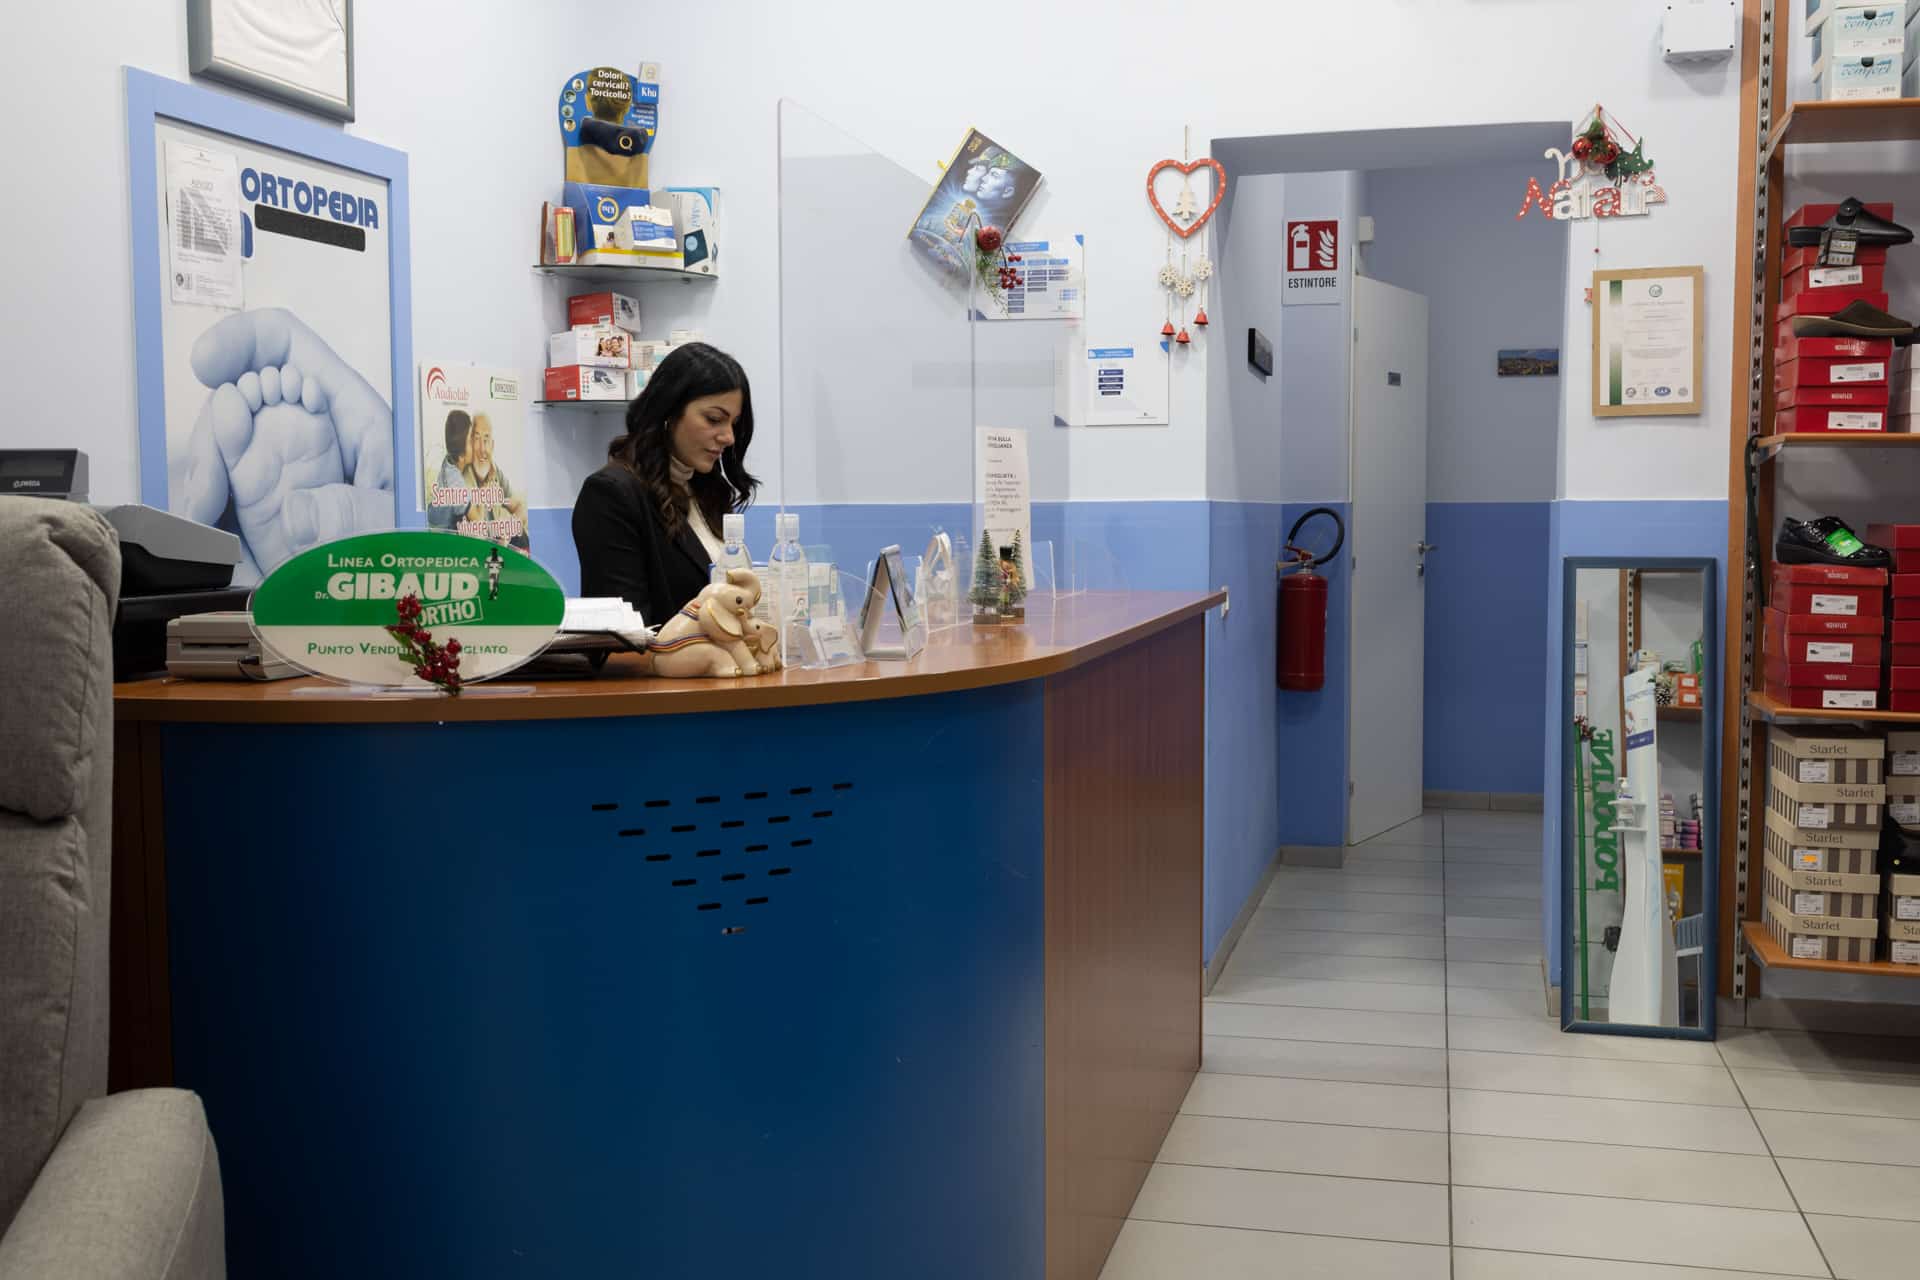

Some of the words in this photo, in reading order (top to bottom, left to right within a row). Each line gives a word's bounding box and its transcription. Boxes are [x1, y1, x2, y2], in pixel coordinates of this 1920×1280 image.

[598, 70, 623, 80] Dolori
[592, 79, 629, 91] cervicali?
[590, 87, 631, 100] Torcicollo?
[241, 167, 378, 229] ORTOPEDIA
[1288, 277, 1337, 289] ESTINTORE
[432, 484, 469, 507] Sentire
[489, 519, 523, 541] meglio
[327, 572, 480, 600] GIBAUD
[1809, 744, 1849, 755] Starlet
[1836, 787, 1875, 798] Starlet
[1805, 832, 1843, 844] Starlet
[1805, 875, 1843, 887] Starlet
[1802, 919, 1840, 931] Starlet
